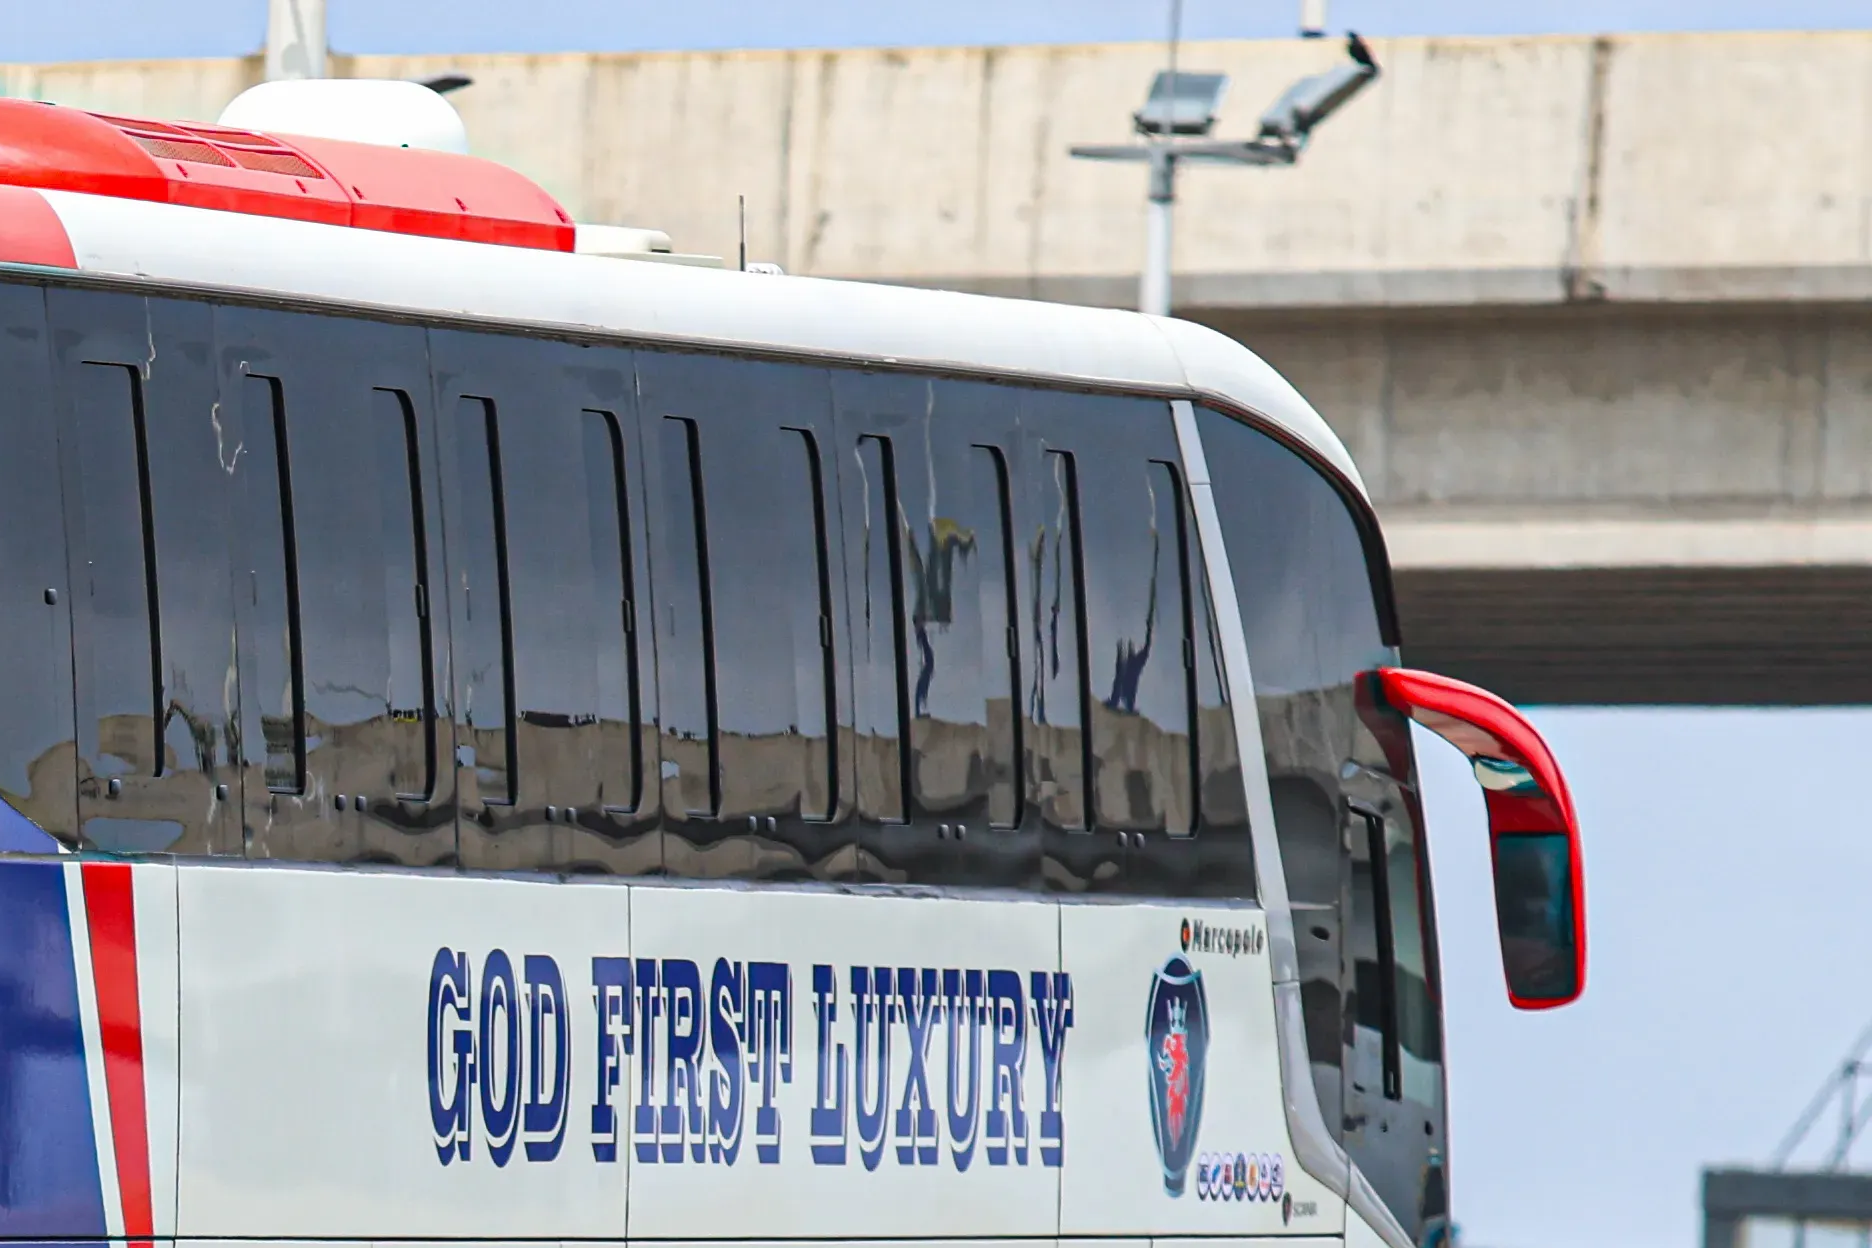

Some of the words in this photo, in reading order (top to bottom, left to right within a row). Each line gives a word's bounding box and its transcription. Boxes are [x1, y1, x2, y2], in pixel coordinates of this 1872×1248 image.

[1192, 919, 1264, 959] Marcopolo
[427, 947, 570, 1167] GOD
[591, 957, 793, 1167] FIRST
[810, 964, 1075, 1172] LUXURY
